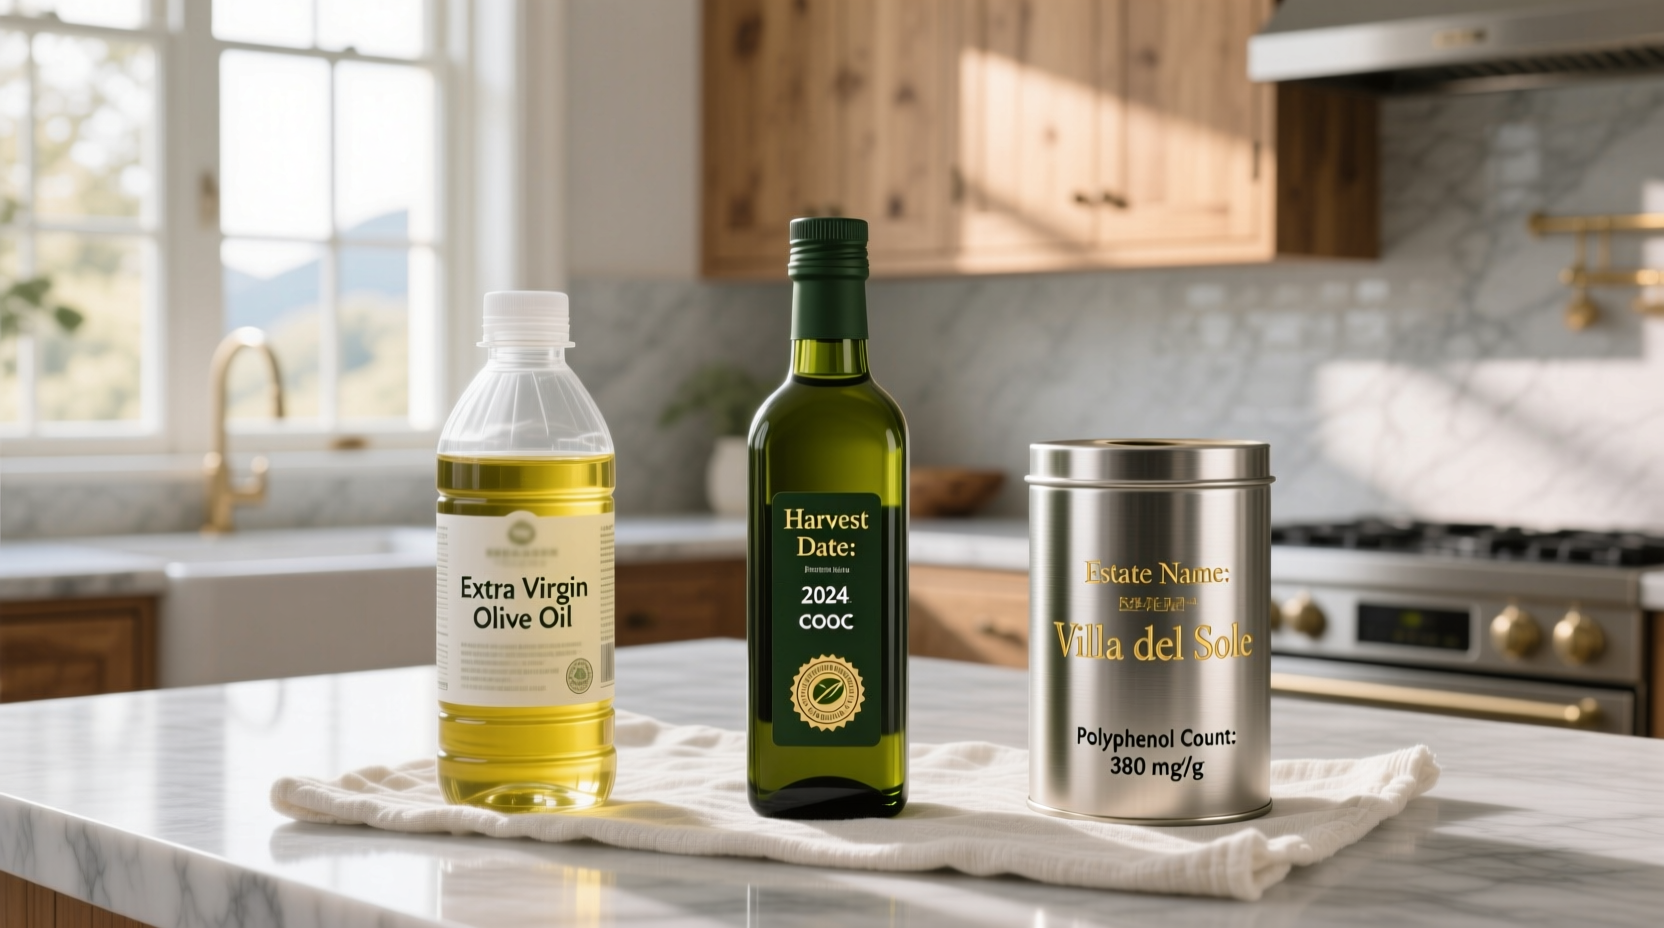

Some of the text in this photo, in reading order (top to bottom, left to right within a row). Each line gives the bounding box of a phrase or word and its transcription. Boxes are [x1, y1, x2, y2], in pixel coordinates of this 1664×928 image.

[783, 508, 869, 530] Harvest
[797, 536, 855, 557] Date:
[1084, 559, 1230, 585] Estate Name:
[461, 575, 588, 605] Extra Virgin
[473, 604, 572, 630] Olive Oil
[799, 613, 854, 630] COOC
[1053, 621, 1253, 661] Villa del Sole
[1077, 727, 1237, 752] Polyphenol Count:
[1110, 756, 1146, 776] 380
